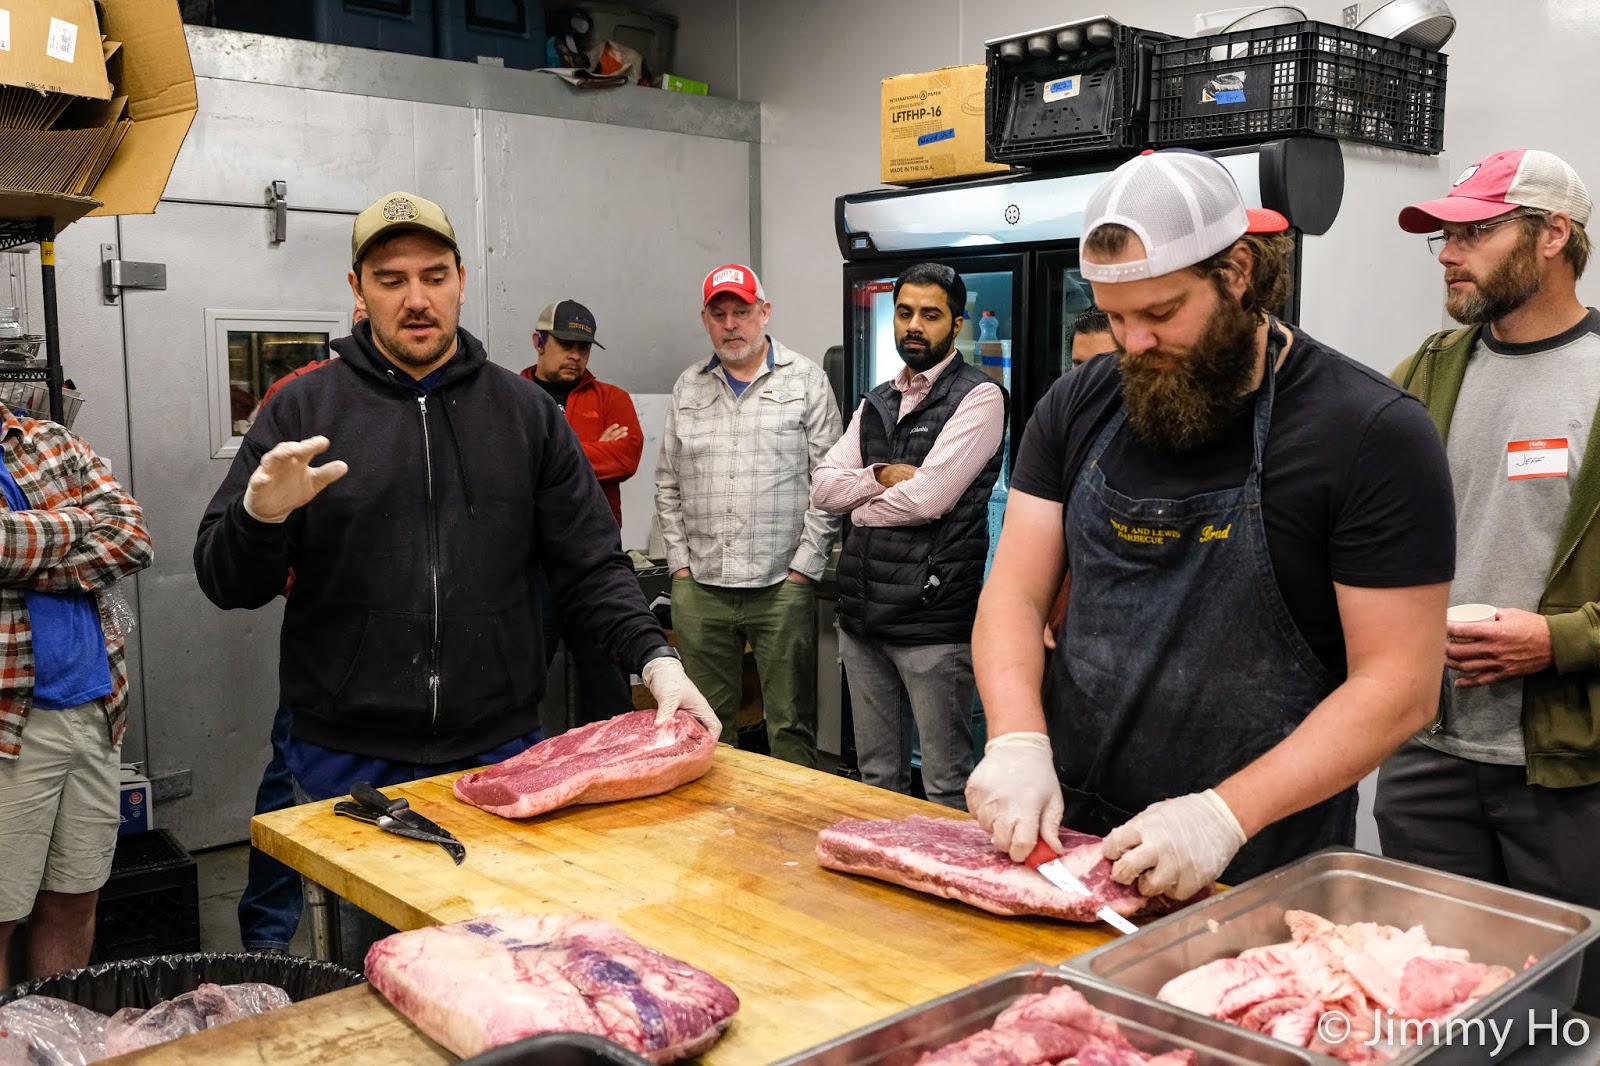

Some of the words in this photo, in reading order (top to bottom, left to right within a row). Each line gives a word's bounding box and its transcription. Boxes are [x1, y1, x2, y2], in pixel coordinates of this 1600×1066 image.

[889, 94, 920, 103] INTERNATIONAL
[892, 105, 942, 123] LFTFHP-16
[1118, 530, 1165, 545] BARBECUE
[1131, 527, 1151, 536] AND
[1152, 529, 1181, 539] LEWIS
[1199, 523, 1232, 543] Brad
